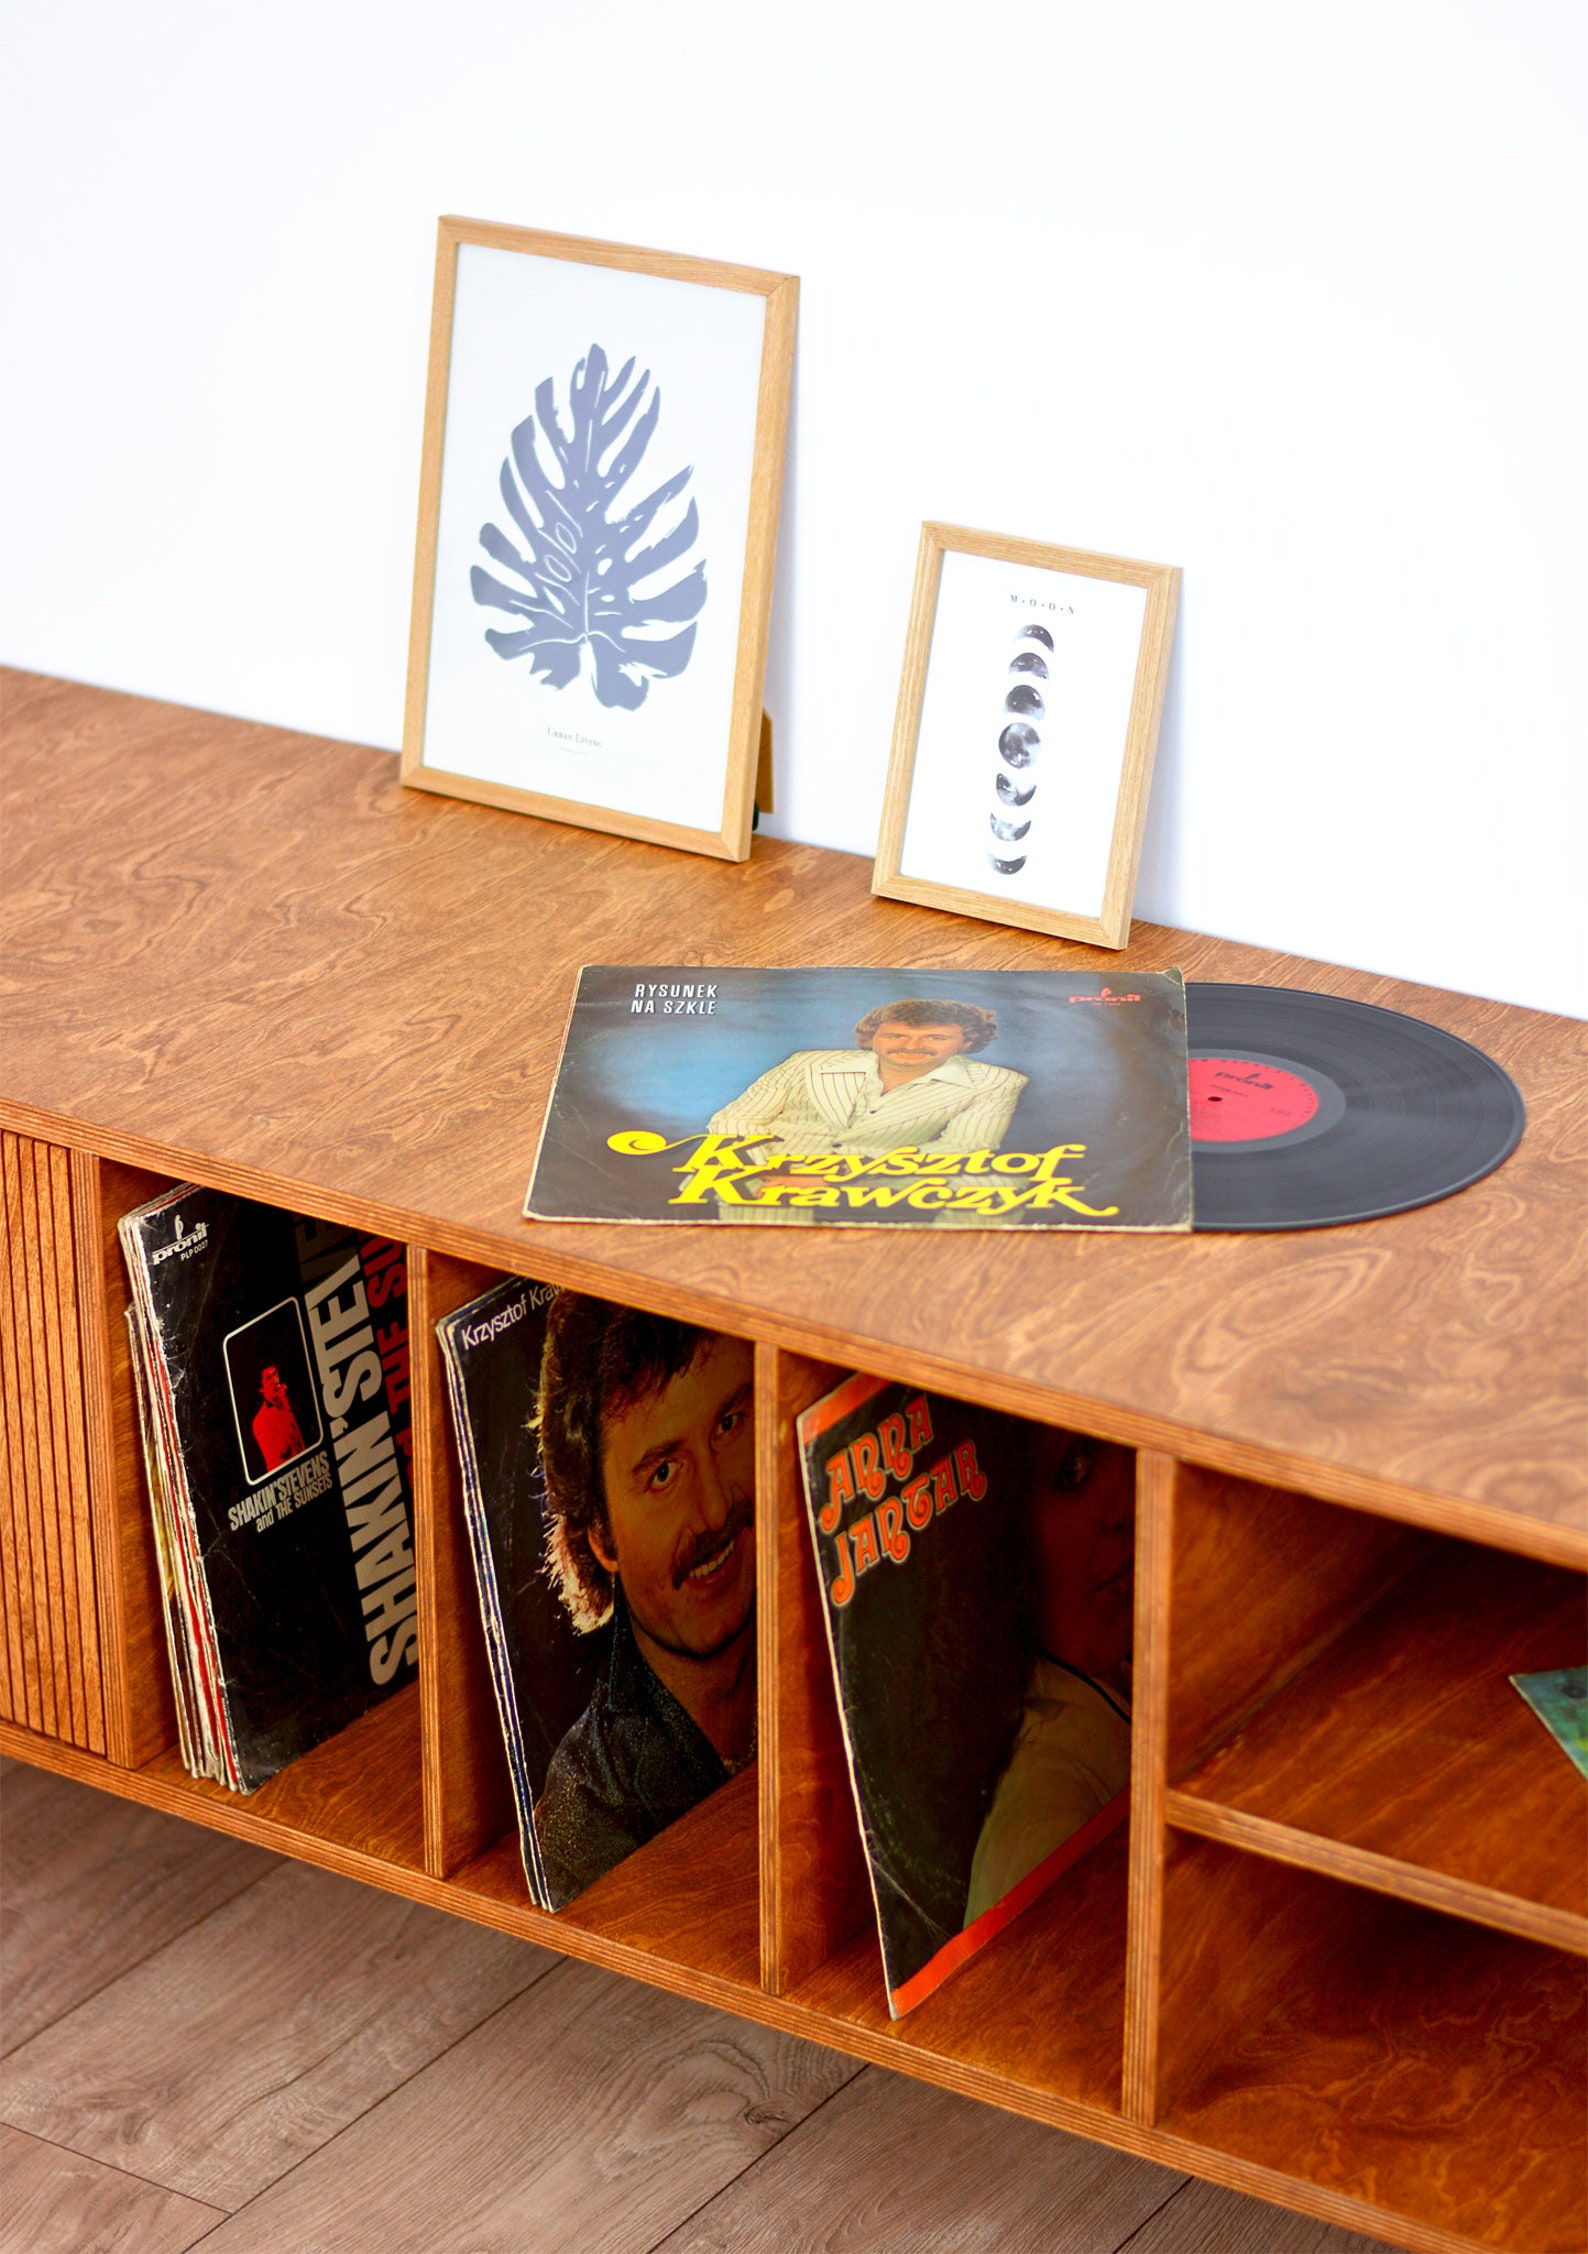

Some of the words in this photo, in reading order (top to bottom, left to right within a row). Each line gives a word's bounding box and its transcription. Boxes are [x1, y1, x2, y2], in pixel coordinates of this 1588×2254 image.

[631, 1000, 655, 1013] NA
[664, 1001, 716, 1015] SZKLE
[634, 984, 718, 998] RYSUNEK
[606, 1130, 1087, 1182] Krzysztof
[668, 1164, 1119, 1217] Krawczyk
[461, 1295, 527, 1350] Krzysztof
[256, 1509, 275, 1533] and
[275, 1497, 293, 1520] THE
[294, 1472, 333, 1509] SUNSETS
